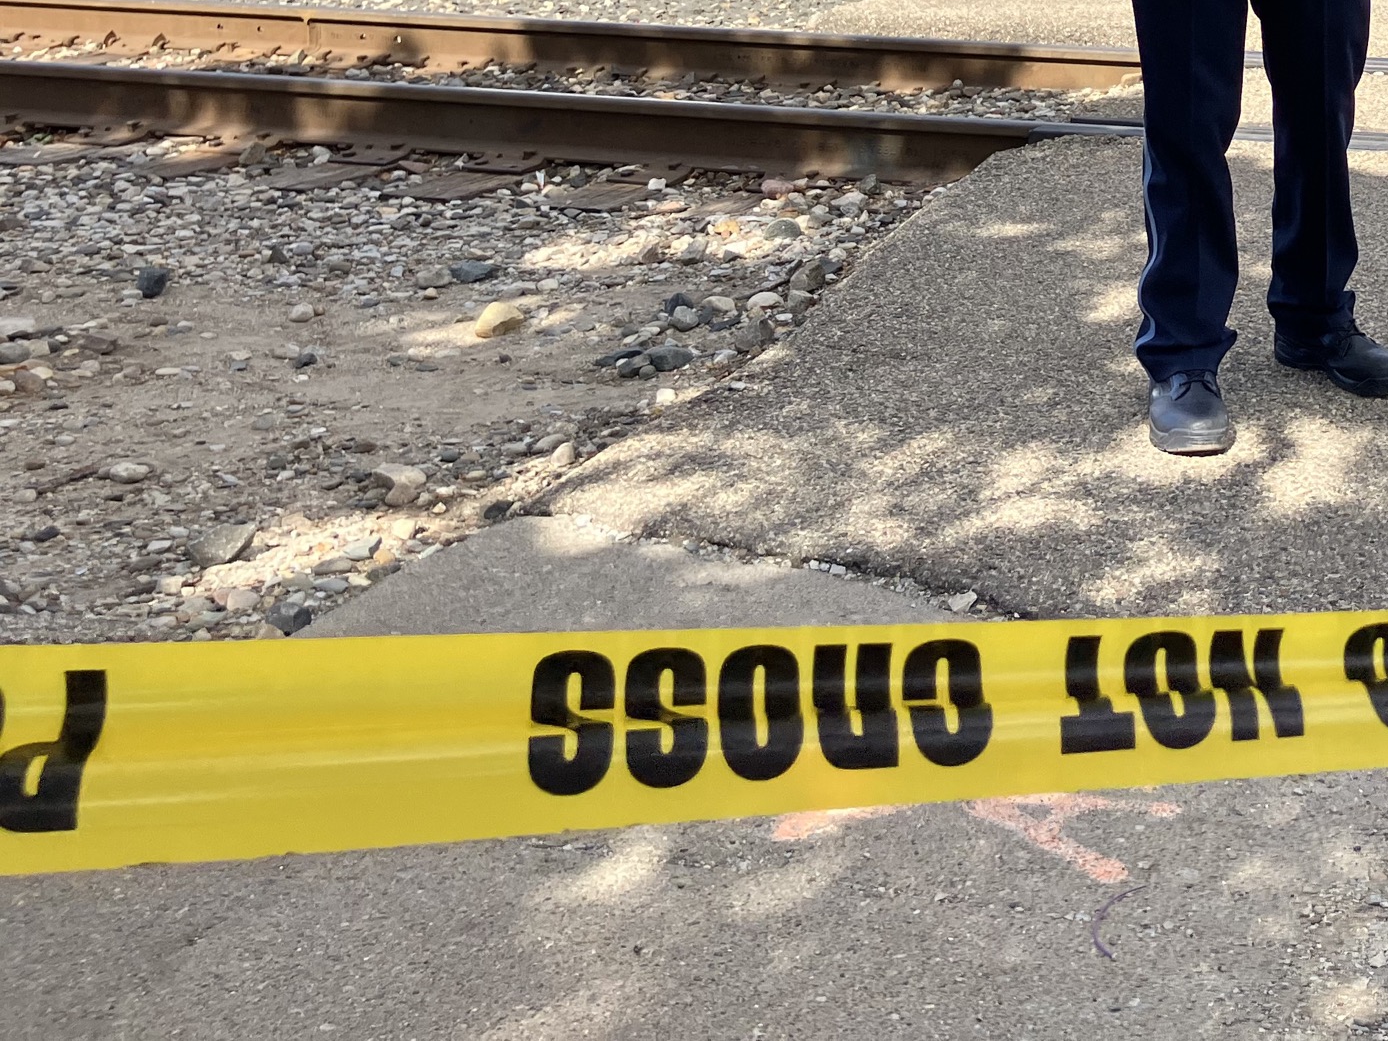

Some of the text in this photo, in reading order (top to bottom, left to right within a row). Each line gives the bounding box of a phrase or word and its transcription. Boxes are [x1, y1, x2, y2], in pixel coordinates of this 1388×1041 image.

[0, 668, 107, 833] P
[528, 638, 994, 794] CROSS
[1061, 627, 1305, 755] NOT
